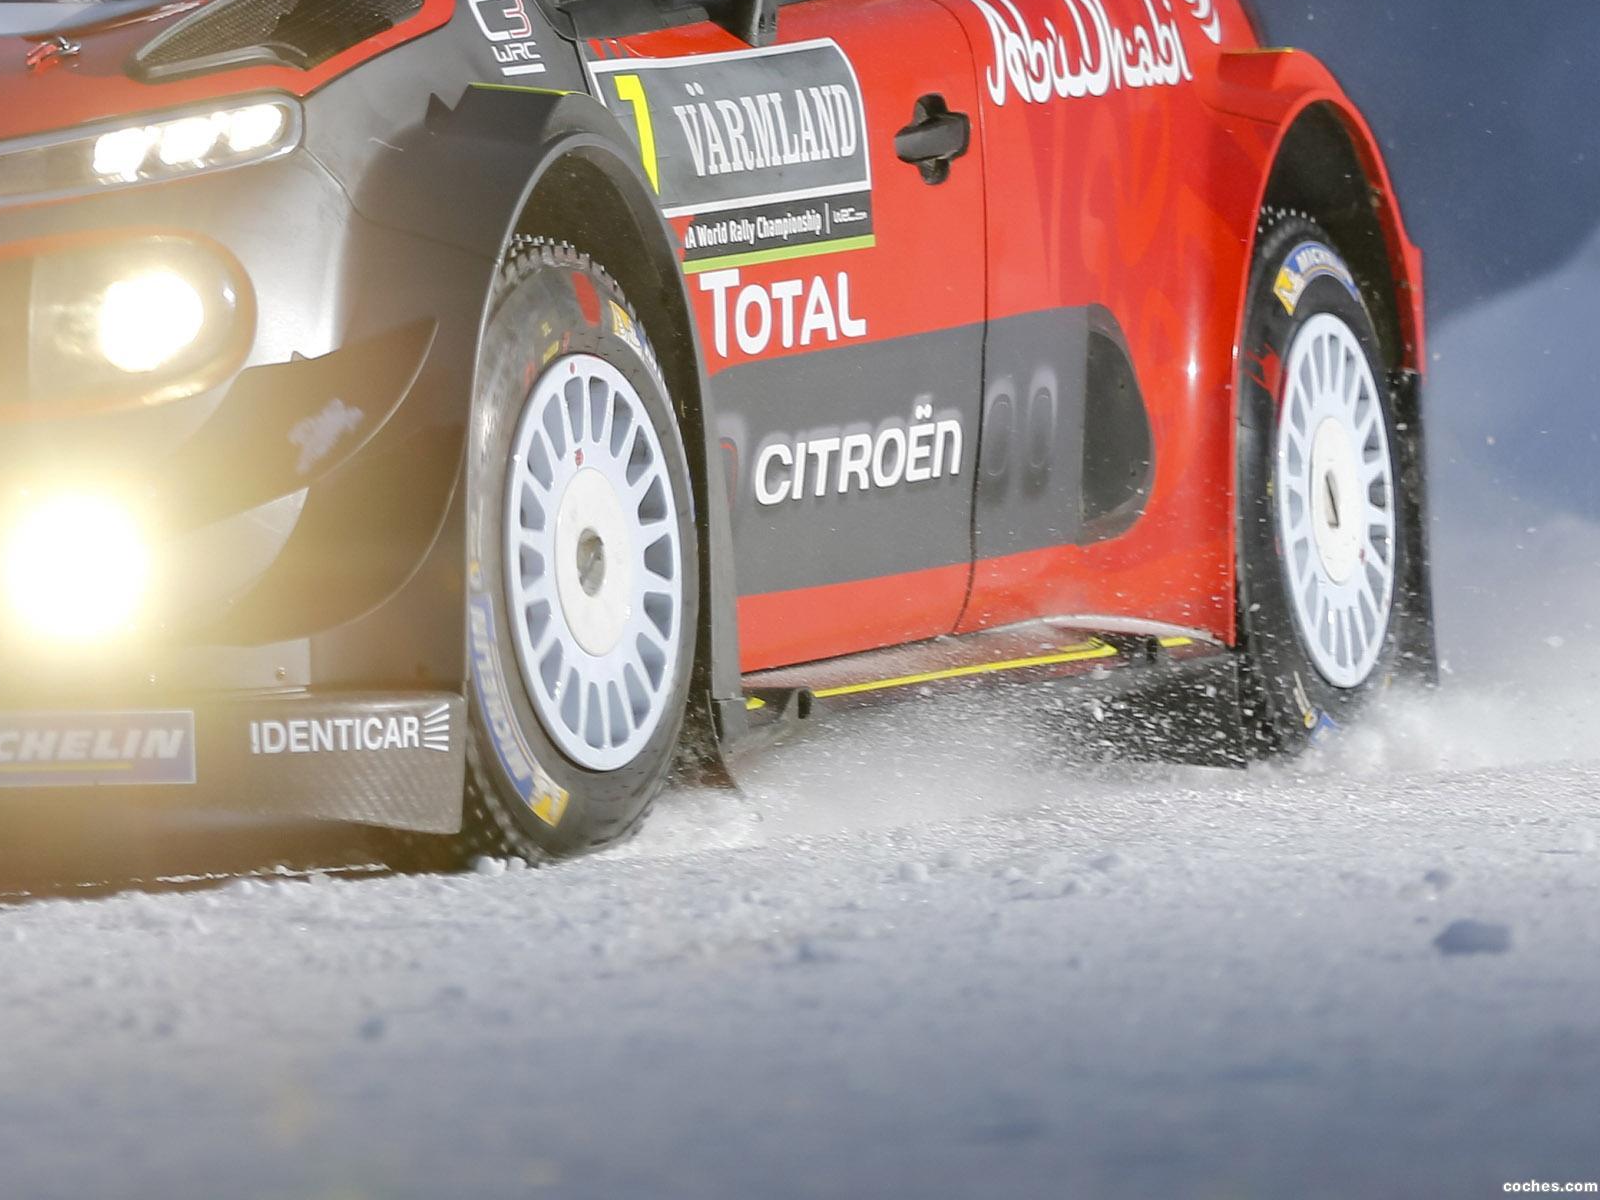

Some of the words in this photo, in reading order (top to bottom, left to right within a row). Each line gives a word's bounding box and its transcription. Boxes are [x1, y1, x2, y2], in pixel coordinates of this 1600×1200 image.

[490, 41, 542, 63] WRC
[673, 82, 857, 177] VÄRMLAND
[696, 221, 728, 248] World
[728, 218, 755, 246] Rally
[756, 208, 823, 241] Championship
[699, 268, 867, 358] TOTAL
[754, 402, 963, 506] CITROËN
[249, 715, 421, 754] IDENTICAR
